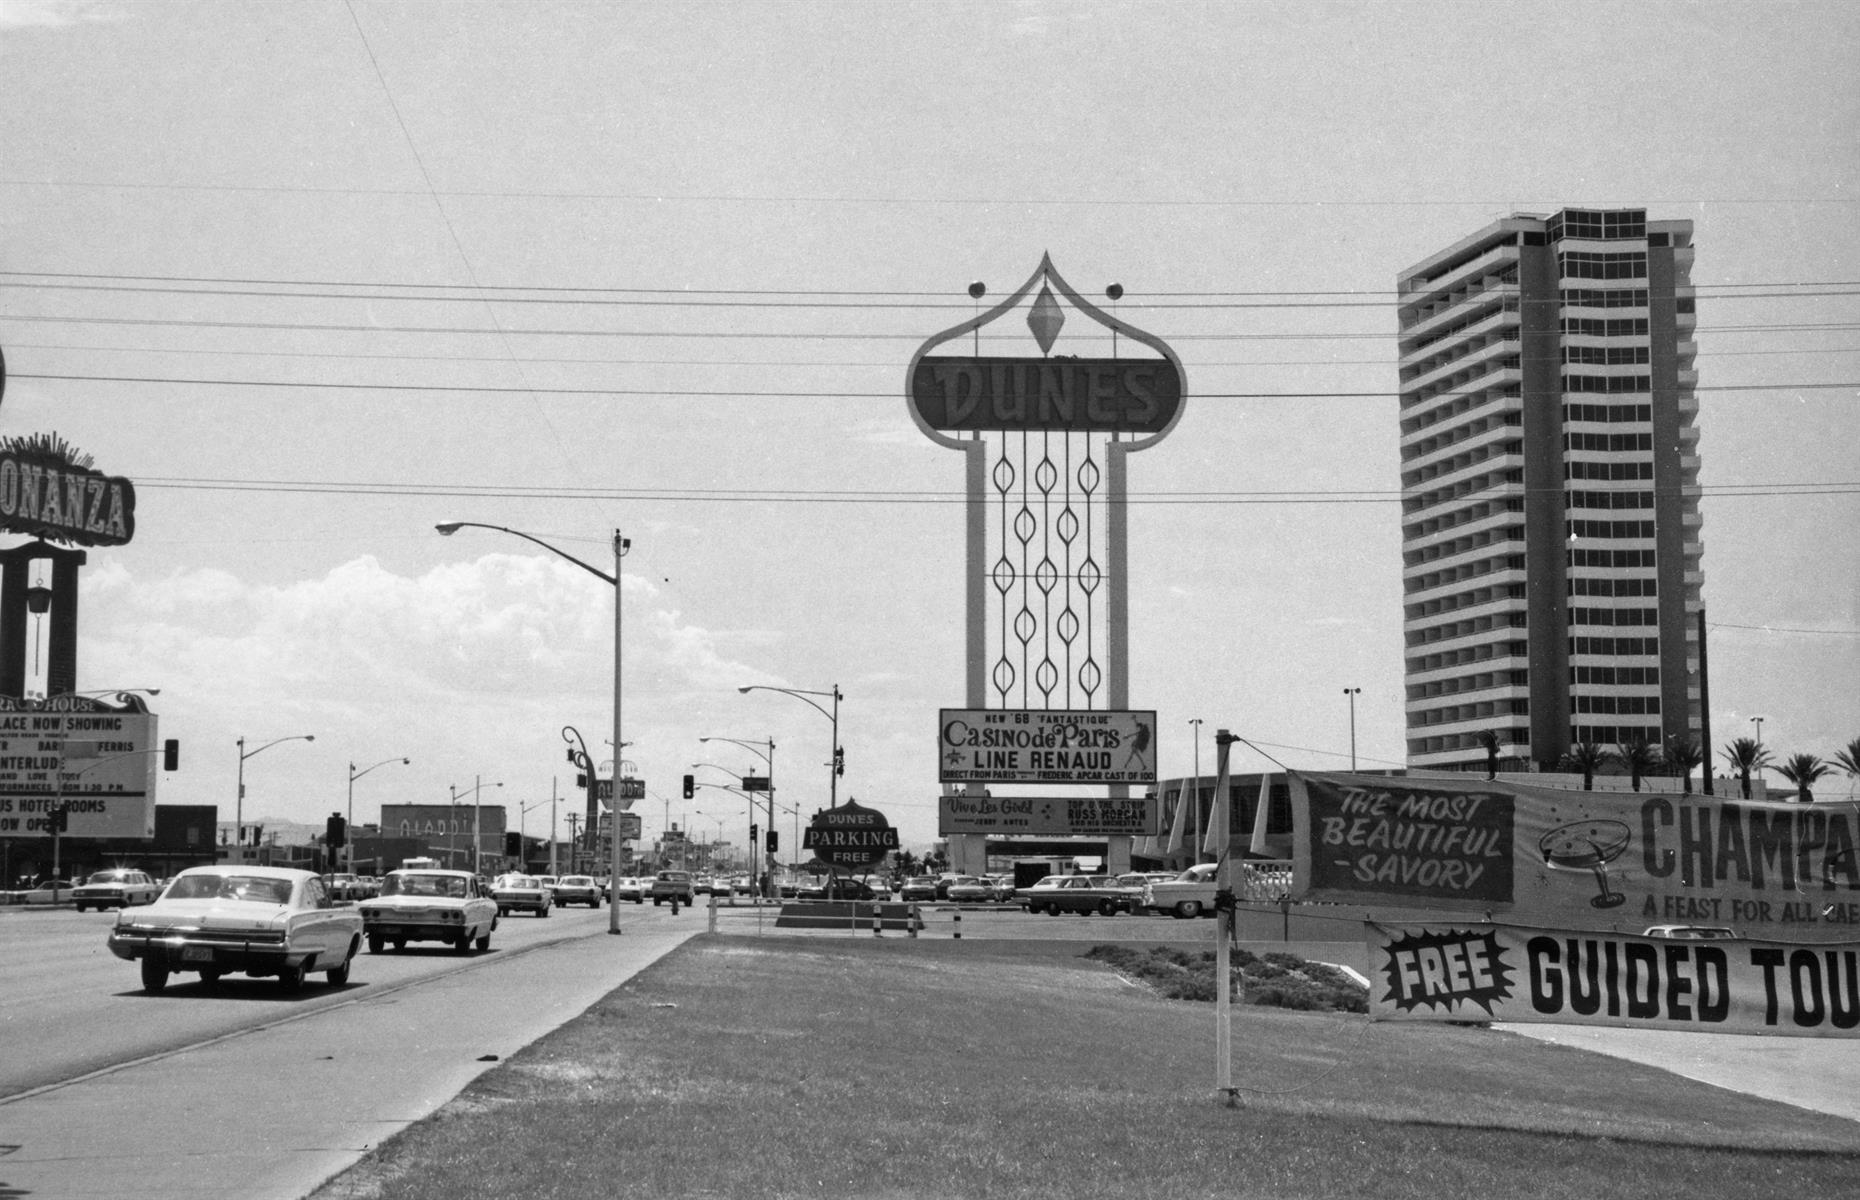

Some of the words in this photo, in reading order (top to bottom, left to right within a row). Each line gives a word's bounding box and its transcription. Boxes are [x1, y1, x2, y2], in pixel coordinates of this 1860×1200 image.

[931, 360, 1159, 426] DUNES
[44, 697, 95, 712] HOUSE
[33, 717, 61, 730] NOW
[67, 717, 122, 731] SHOWING
[985, 715, 1006, 723] NEW
[1052, 723, 1120, 749] Paris
[98, 741, 134, 752] FERRIS
[974, 751, 1018, 769] LINE
[1031, 751, 1111, 770] RENAUD
[943, 770, 968, 778] DIRECT
[970, 770, 991, 779] FROM
[993, 771, 1016, 779] PARIS
[1105, 772, 1125, 780] CAST
[1128, 772, 1138, 780] OF
[1140, 772, 1154, 780] 100
[64, 800, 106, 813] ROOMS
[1068, 800, 1084, 809] TOP
[1338, 785, 1392, 816] THE
[1397, 794, 1489, 822] MOST
[827, 814, 875, 824] DUNES
[1068, 809, 1097, 820] RUSS
[809, 831, 894, 846] PARKING
[1321, 817, 1502, 857] BEAUTIFUL
[833, 852, 870, 862] FREE
[1643, 894, 1657, 916] A
[1664, 896, 1722, 920] FEAST
[1732, 899, 1773, 922] FOR
[1781, 901, 1817, 922] ALL
[1396, 939, 1495, 1000] FREE
[1527, 936, 1729, 1023] GUIDED
